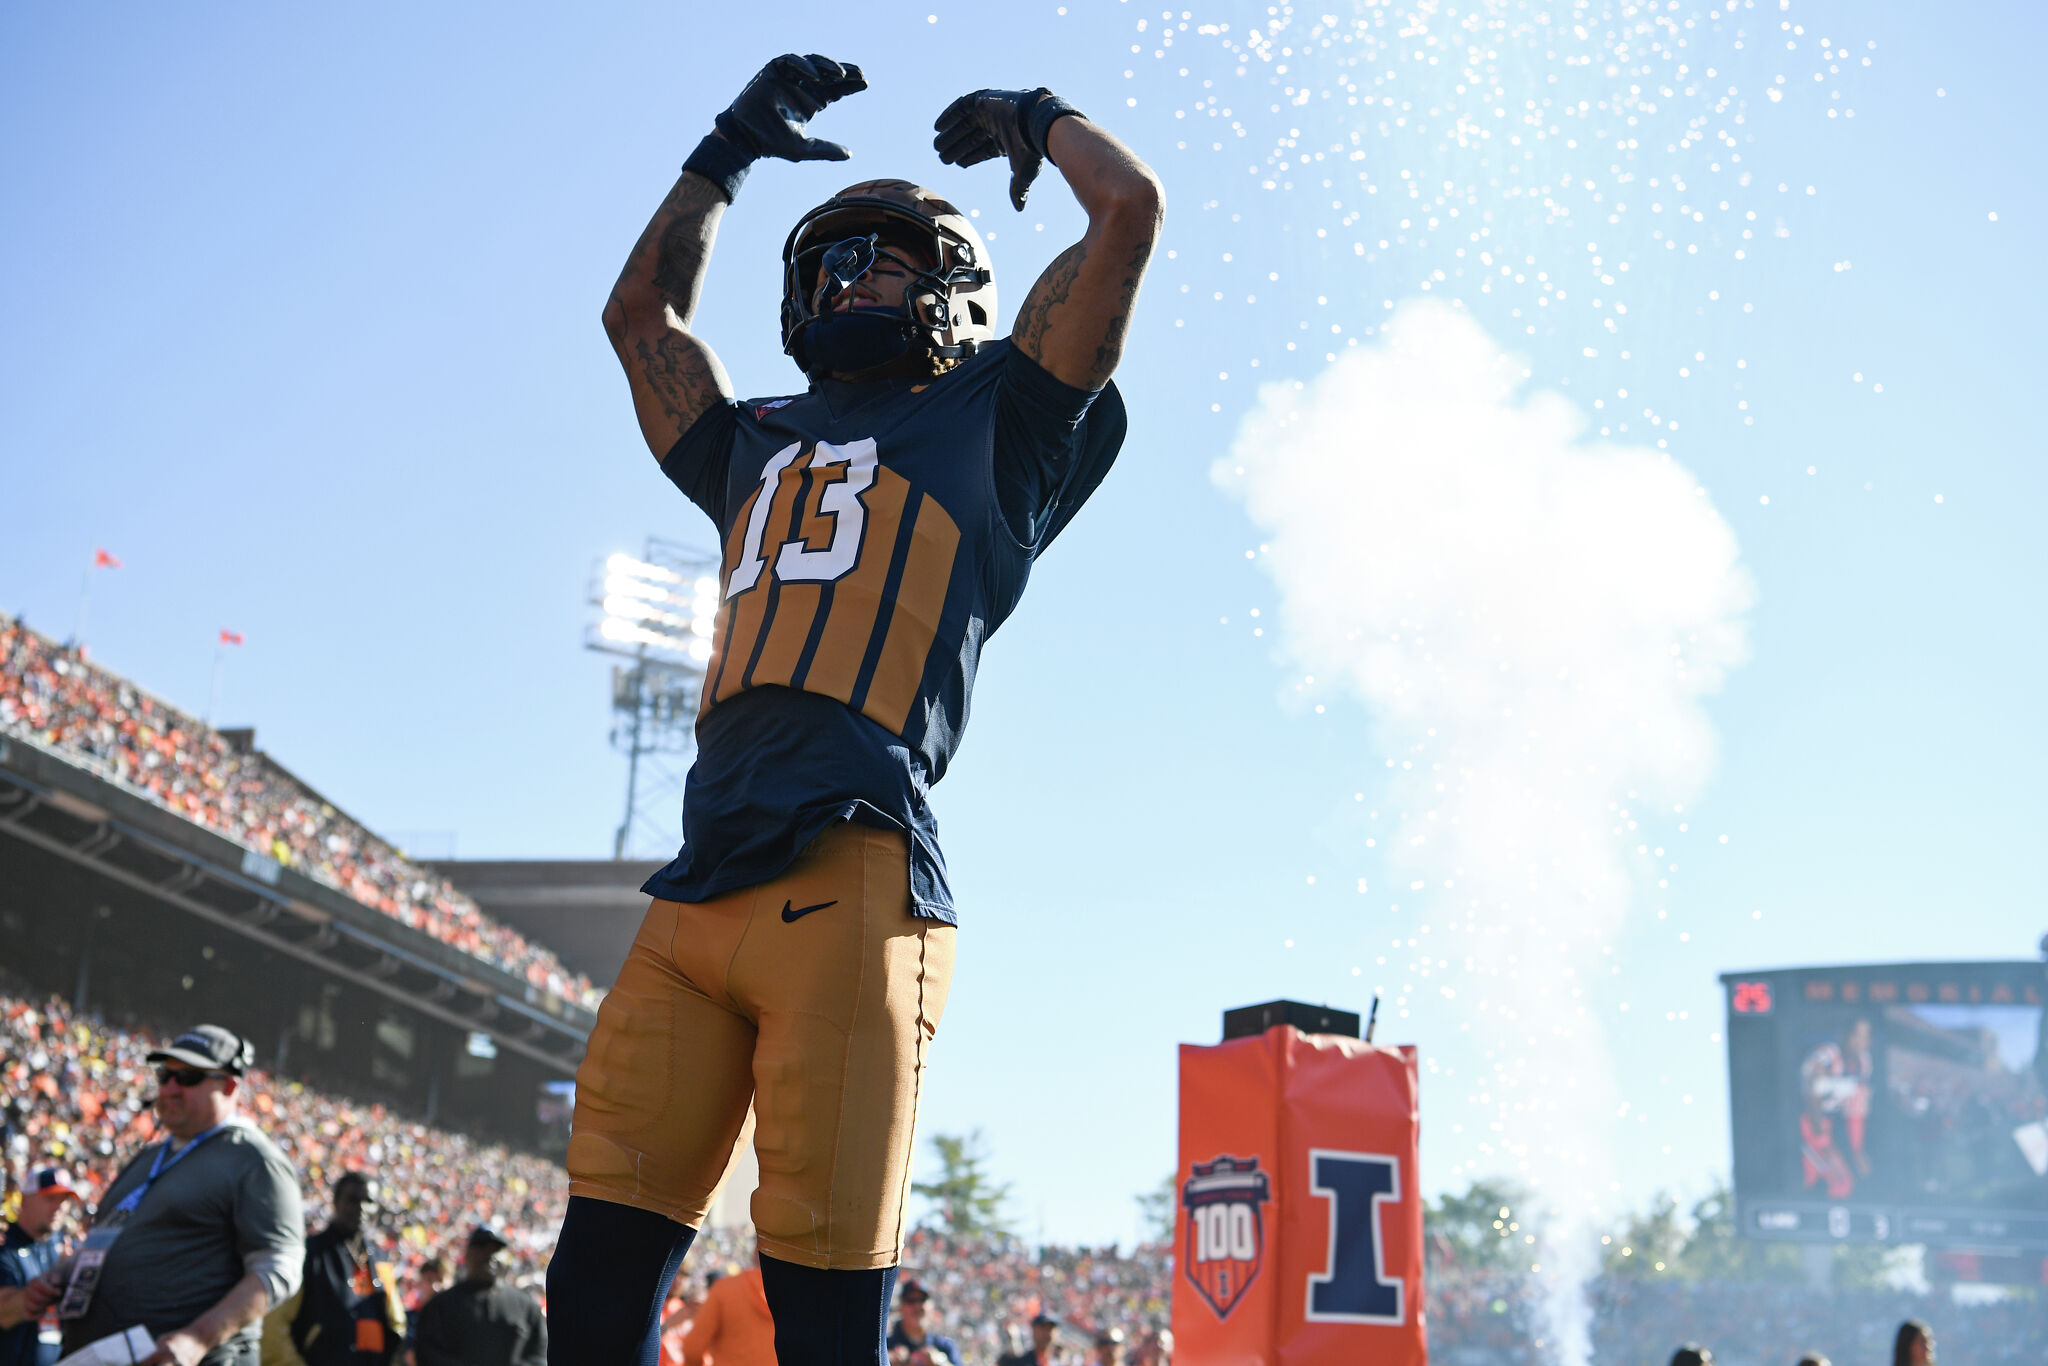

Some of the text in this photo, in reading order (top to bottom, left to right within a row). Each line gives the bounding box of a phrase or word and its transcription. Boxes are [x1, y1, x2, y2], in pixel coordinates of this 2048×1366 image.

[725, 436, 878, 600] 13
[1194, 1204, 1254, 1263] 100
[1305, 1148, 1405, 1326] I
